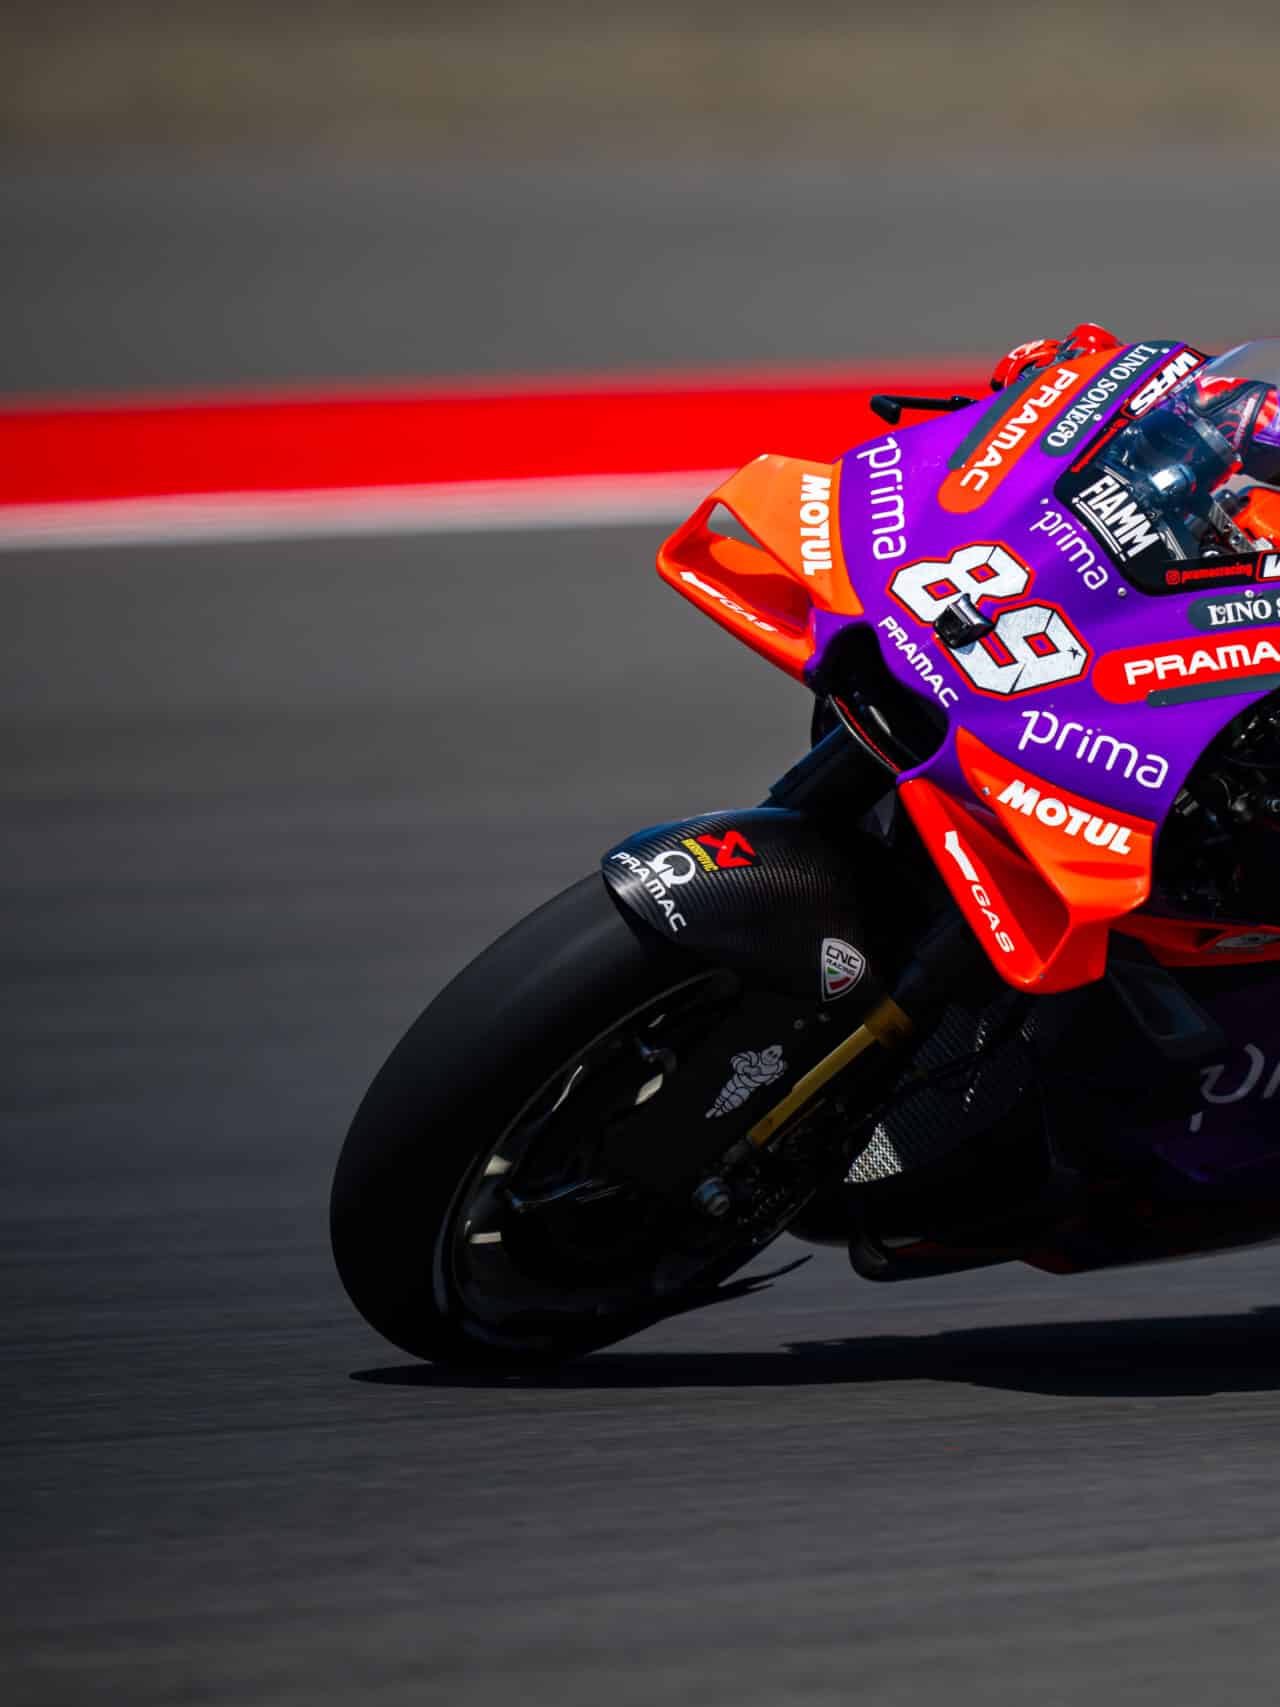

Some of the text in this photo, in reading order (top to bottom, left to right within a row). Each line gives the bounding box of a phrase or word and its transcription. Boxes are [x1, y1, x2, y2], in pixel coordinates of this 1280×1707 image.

[1109, 343, 1159, 382] LINO
[1130, 350, 1199, 416] WRS
[960, 368, 1080, 492] PRAMAC
[1047, 379, 1118, 448] SONEGO
[800, 474, 832, 576] MOTUL
[856, 436, 907, 560] prima
[1079, 474, 1160, 558] FIAMM
[1029, 510, 1108, 591] prima
[887, 543, 1092, 697] 89
[1209, 598, 1271, 626] LINO
[878, 615, 958, 708] PRAMAC
[1018, 710, 1168, 789] prima
[996, 779, 1132, 855] MOTUL
[611, 851, 687, 932] PRAMAC
[970, 884, 1015, 953] GAS
[826, 945, 860, 970] CNC
